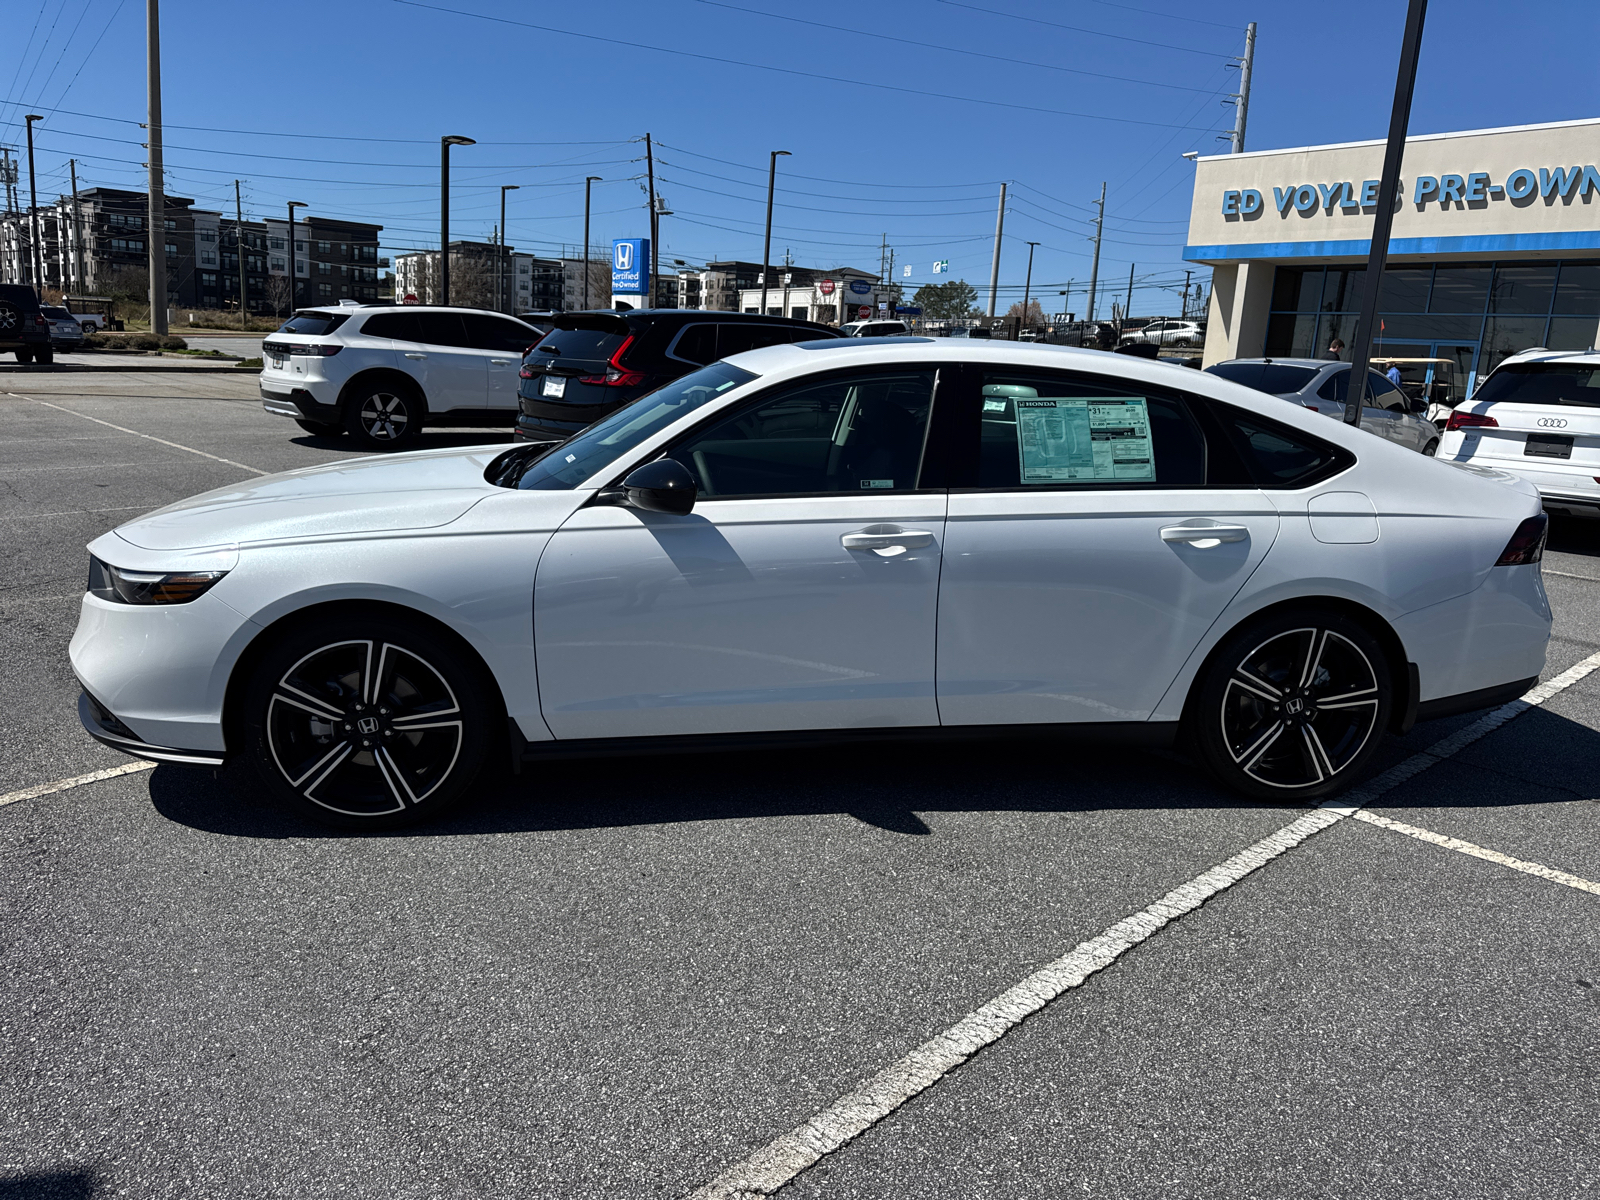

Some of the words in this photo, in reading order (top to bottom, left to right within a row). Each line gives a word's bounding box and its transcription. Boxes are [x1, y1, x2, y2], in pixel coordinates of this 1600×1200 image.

[1222, 188, 1262, 215] ED
[1273, 179, 1400, 213] VOYLE
[612, 271, 639, 280] Certified
[1092, 407, 1101, 415] 31
